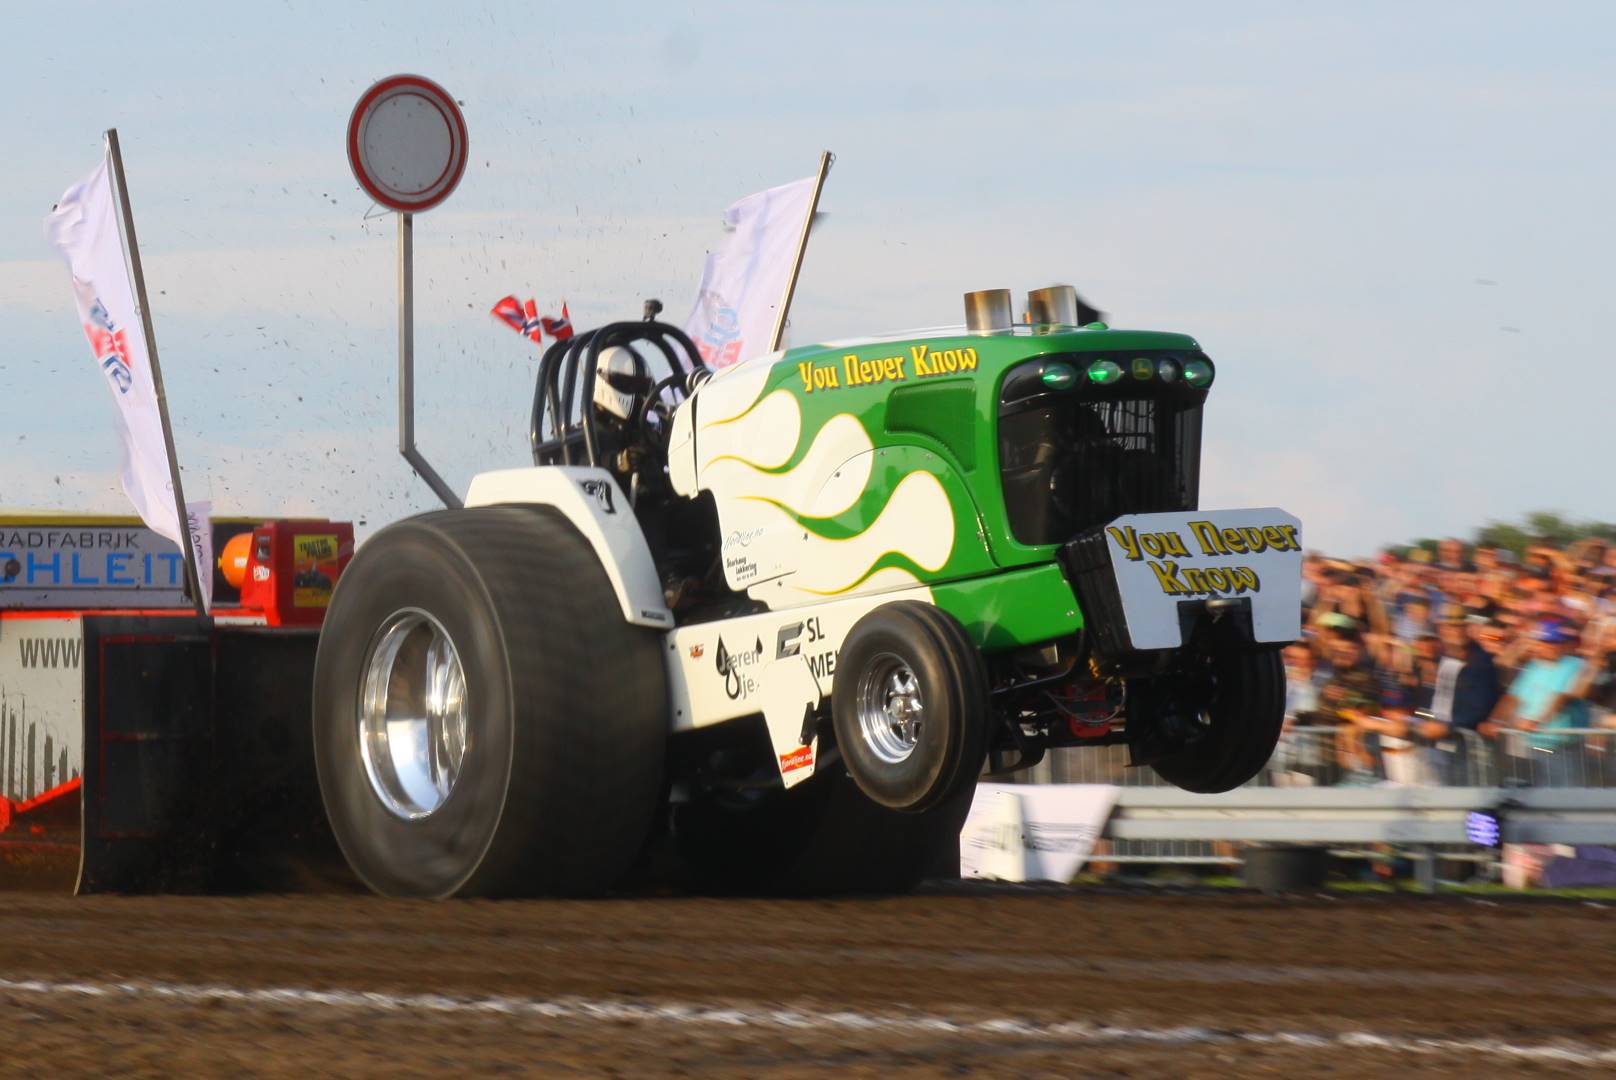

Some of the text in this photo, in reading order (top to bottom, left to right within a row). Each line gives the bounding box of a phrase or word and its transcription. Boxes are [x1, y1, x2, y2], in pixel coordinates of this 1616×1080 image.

[799, 345, 978, 393] You Never Know
[1106, 520, 1302, 561] You Never
[1147, 561, 1260, 595] Know
[806, 616, 825, 642] SL
[811, 650, 841, 679] ME
